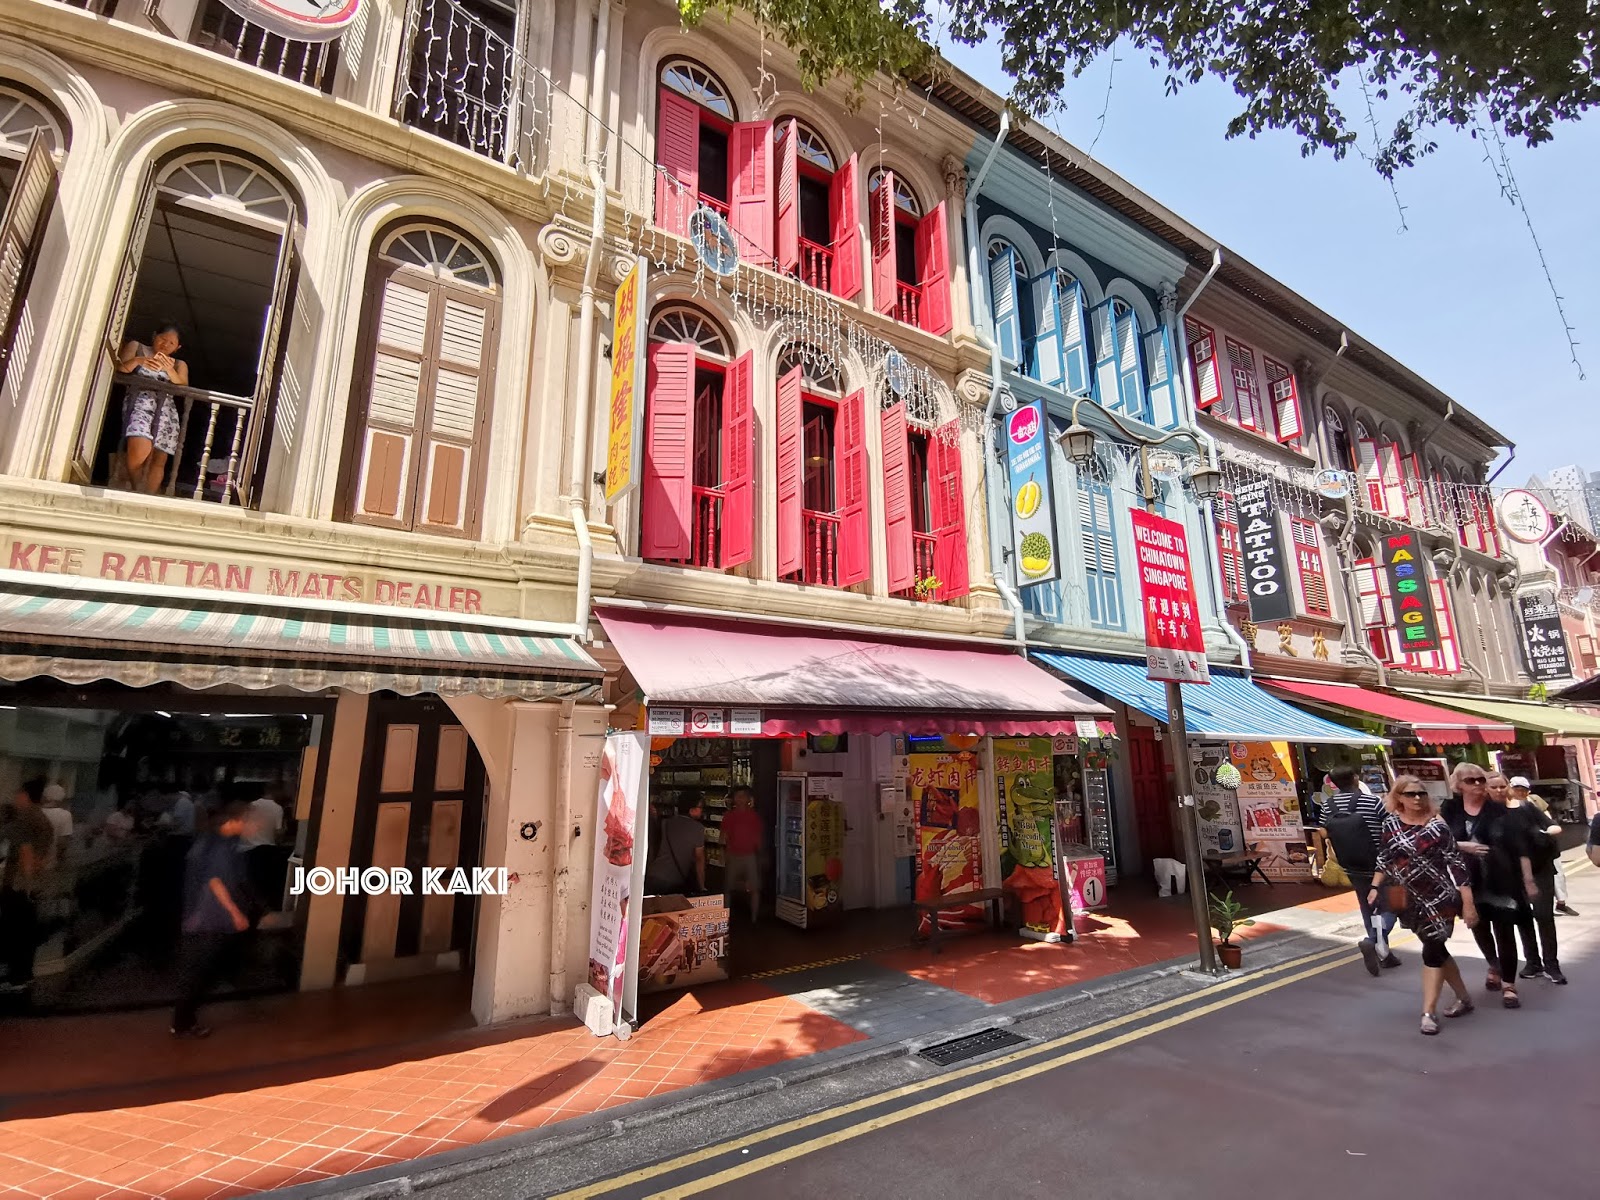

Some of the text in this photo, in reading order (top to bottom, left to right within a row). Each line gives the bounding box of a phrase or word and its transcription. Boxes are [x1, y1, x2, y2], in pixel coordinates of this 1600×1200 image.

[1234, 479, 1269, 495] SEVEN
[1134, 524, 1185, 553] WELCOME TO
[1240, 502, 1279, 596] TATTOO
[1140, 546, 1186, 571] CHINATOWN
[100, 551, 254, 593] RATTAN
[266, 567, 364, 602] MATS
[374, 579, 482, 615] DEALER
[1143, 566, 1188, 591] SINGAPORE
[1388, 534, 1427, 640] MASSAGE
[1148, 596, 1191, 620] 欢迎来到
[1157, 618, 1188, 639] 牛车水
[1527, 623, 1560, 642] 火锅
[1531, 644, 1565, 658] 烧烤
[1171, 708, 1179, 721] 9
[708, 936, 725, 961] $1
